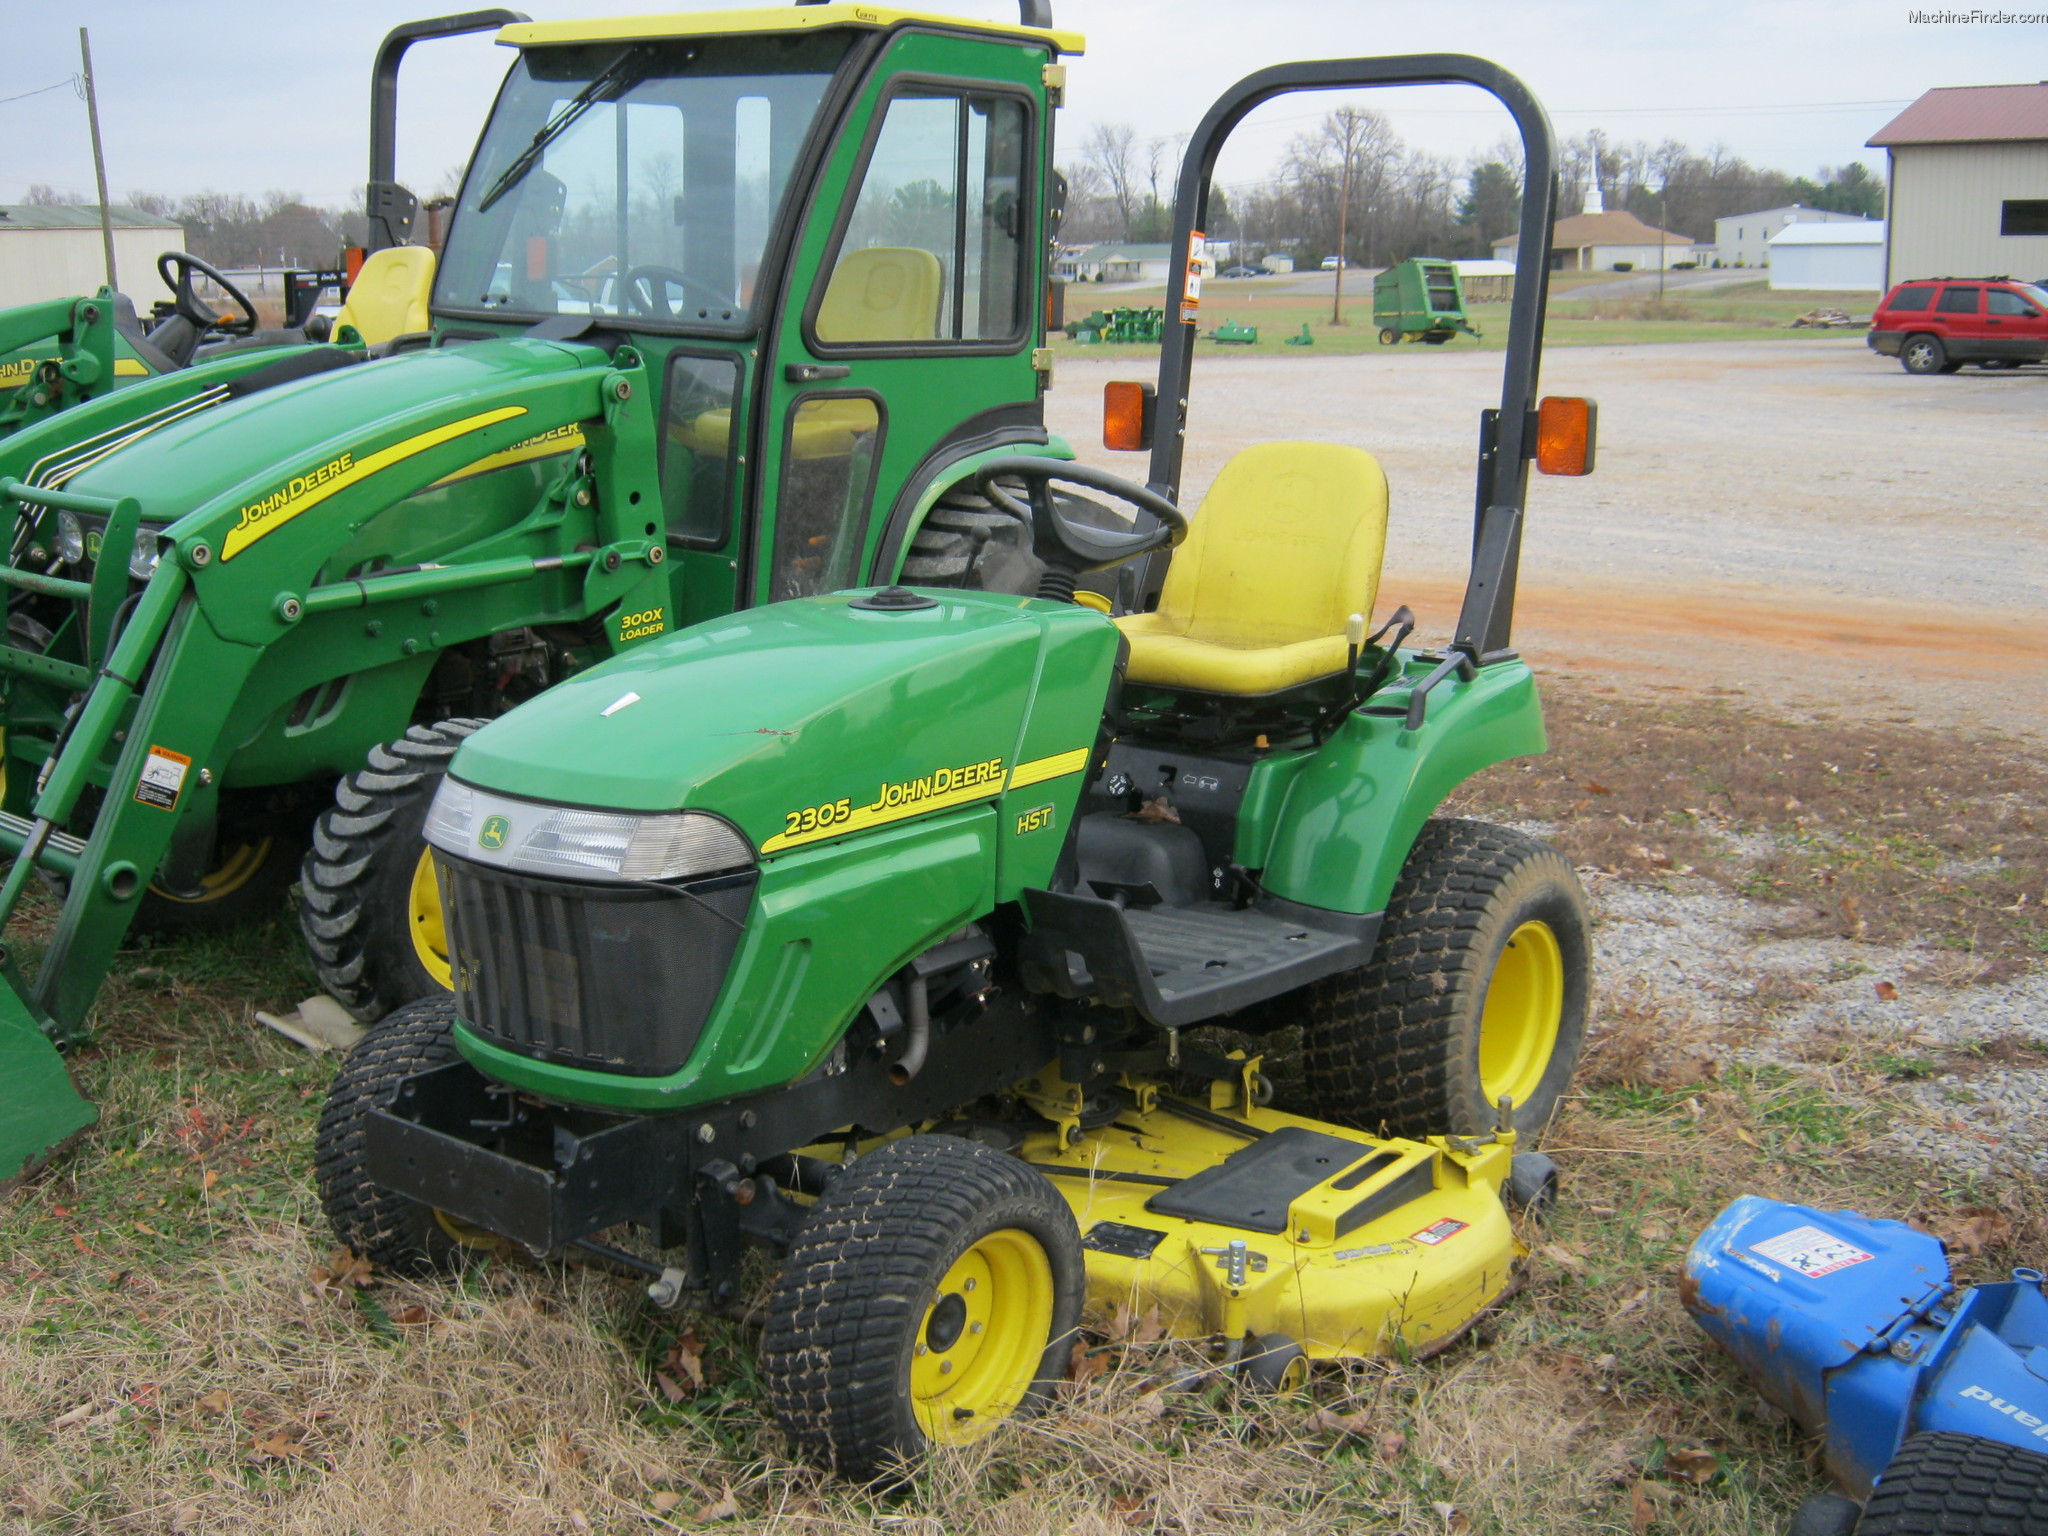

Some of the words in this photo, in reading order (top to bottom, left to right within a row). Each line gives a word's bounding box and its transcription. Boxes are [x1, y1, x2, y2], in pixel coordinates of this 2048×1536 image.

[235, 488, 290, 530] JOHN
[287, 452, 354, 501] DEERE
[619, 622, 665, 642] LOADER
[621, 606, 664, 630] 300X
[784, 798, 851, 836] 2305
[871, 776, 932, 812] JOHN
[932, 757, 1002, 795] DEERE
[1015, 807, 1052, 836] HST
